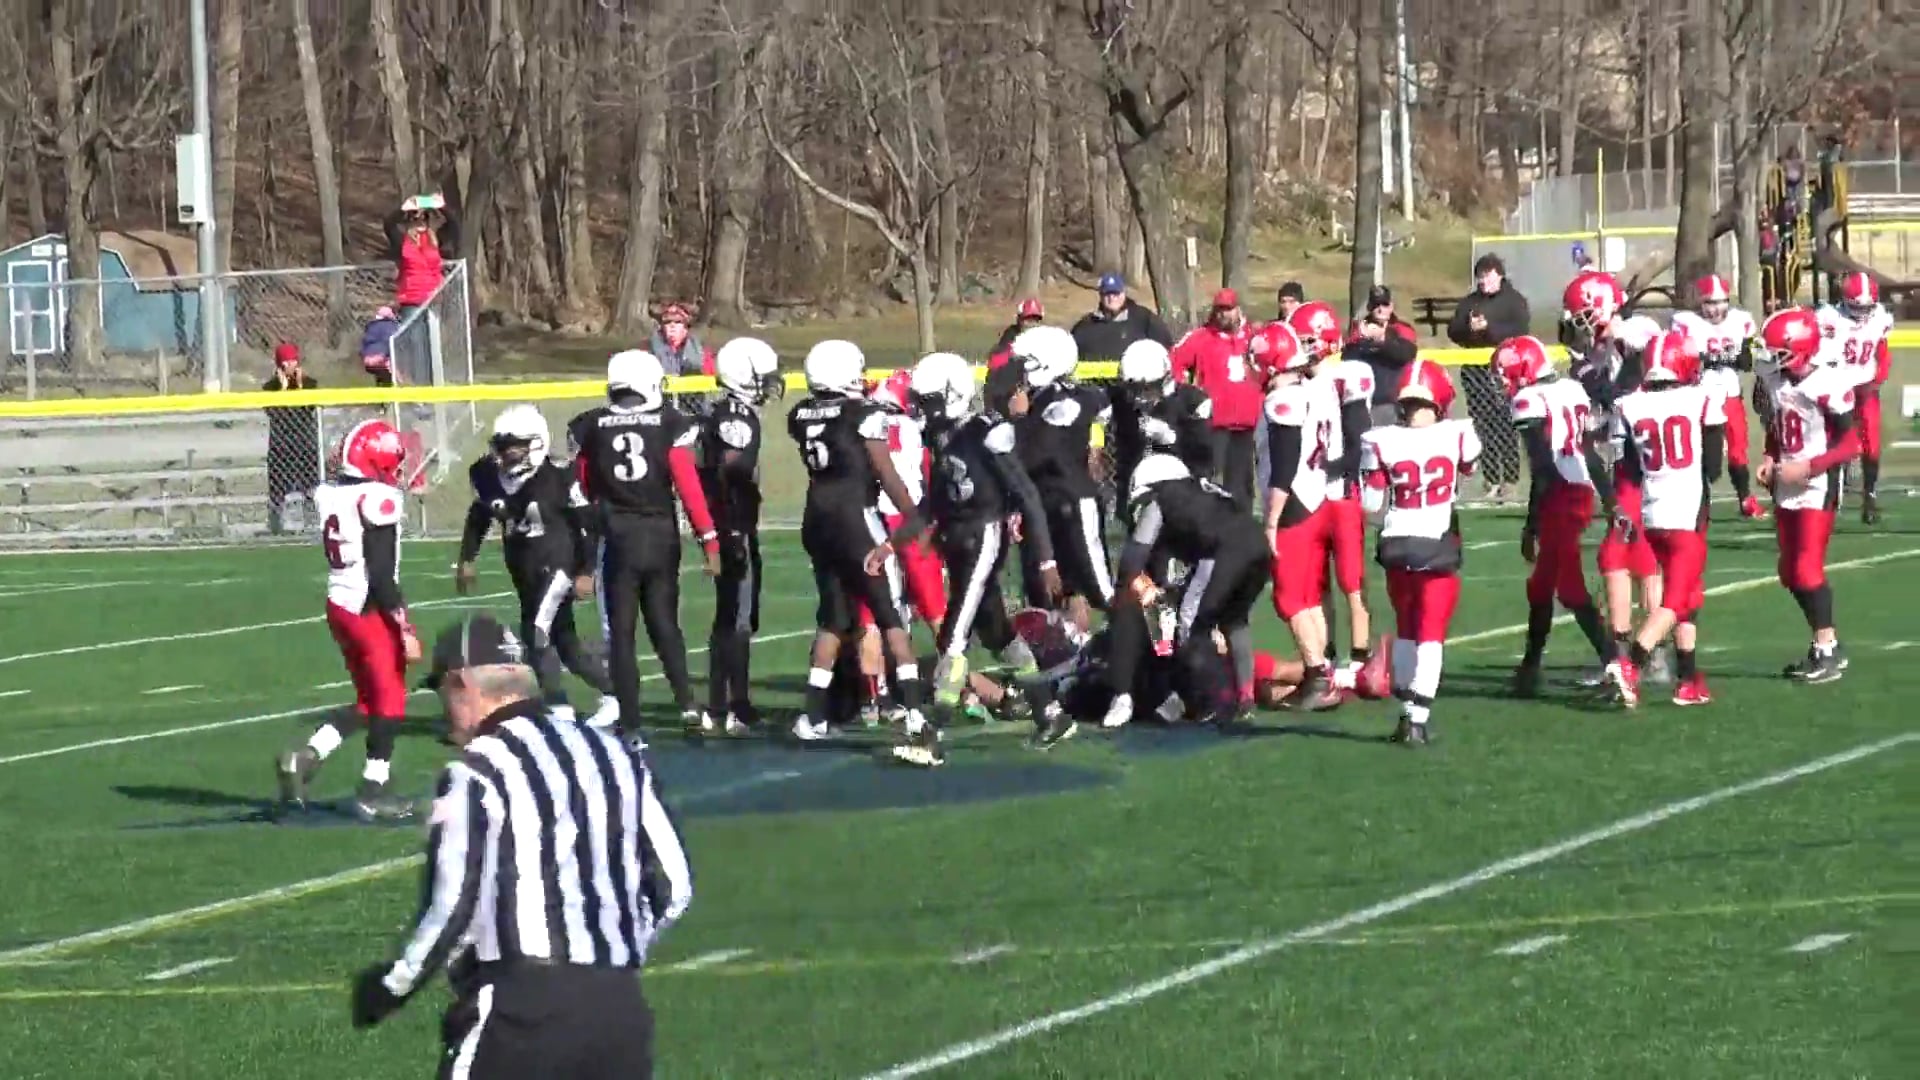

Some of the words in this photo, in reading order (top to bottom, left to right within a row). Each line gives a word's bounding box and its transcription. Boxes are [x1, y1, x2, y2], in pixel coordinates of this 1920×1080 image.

[612, 432, 648, 481] 3
[806, 423, 829, 470] 5
[1634, 415, 1694, 471] 30
[1392, 455, 1454, 509] 22
